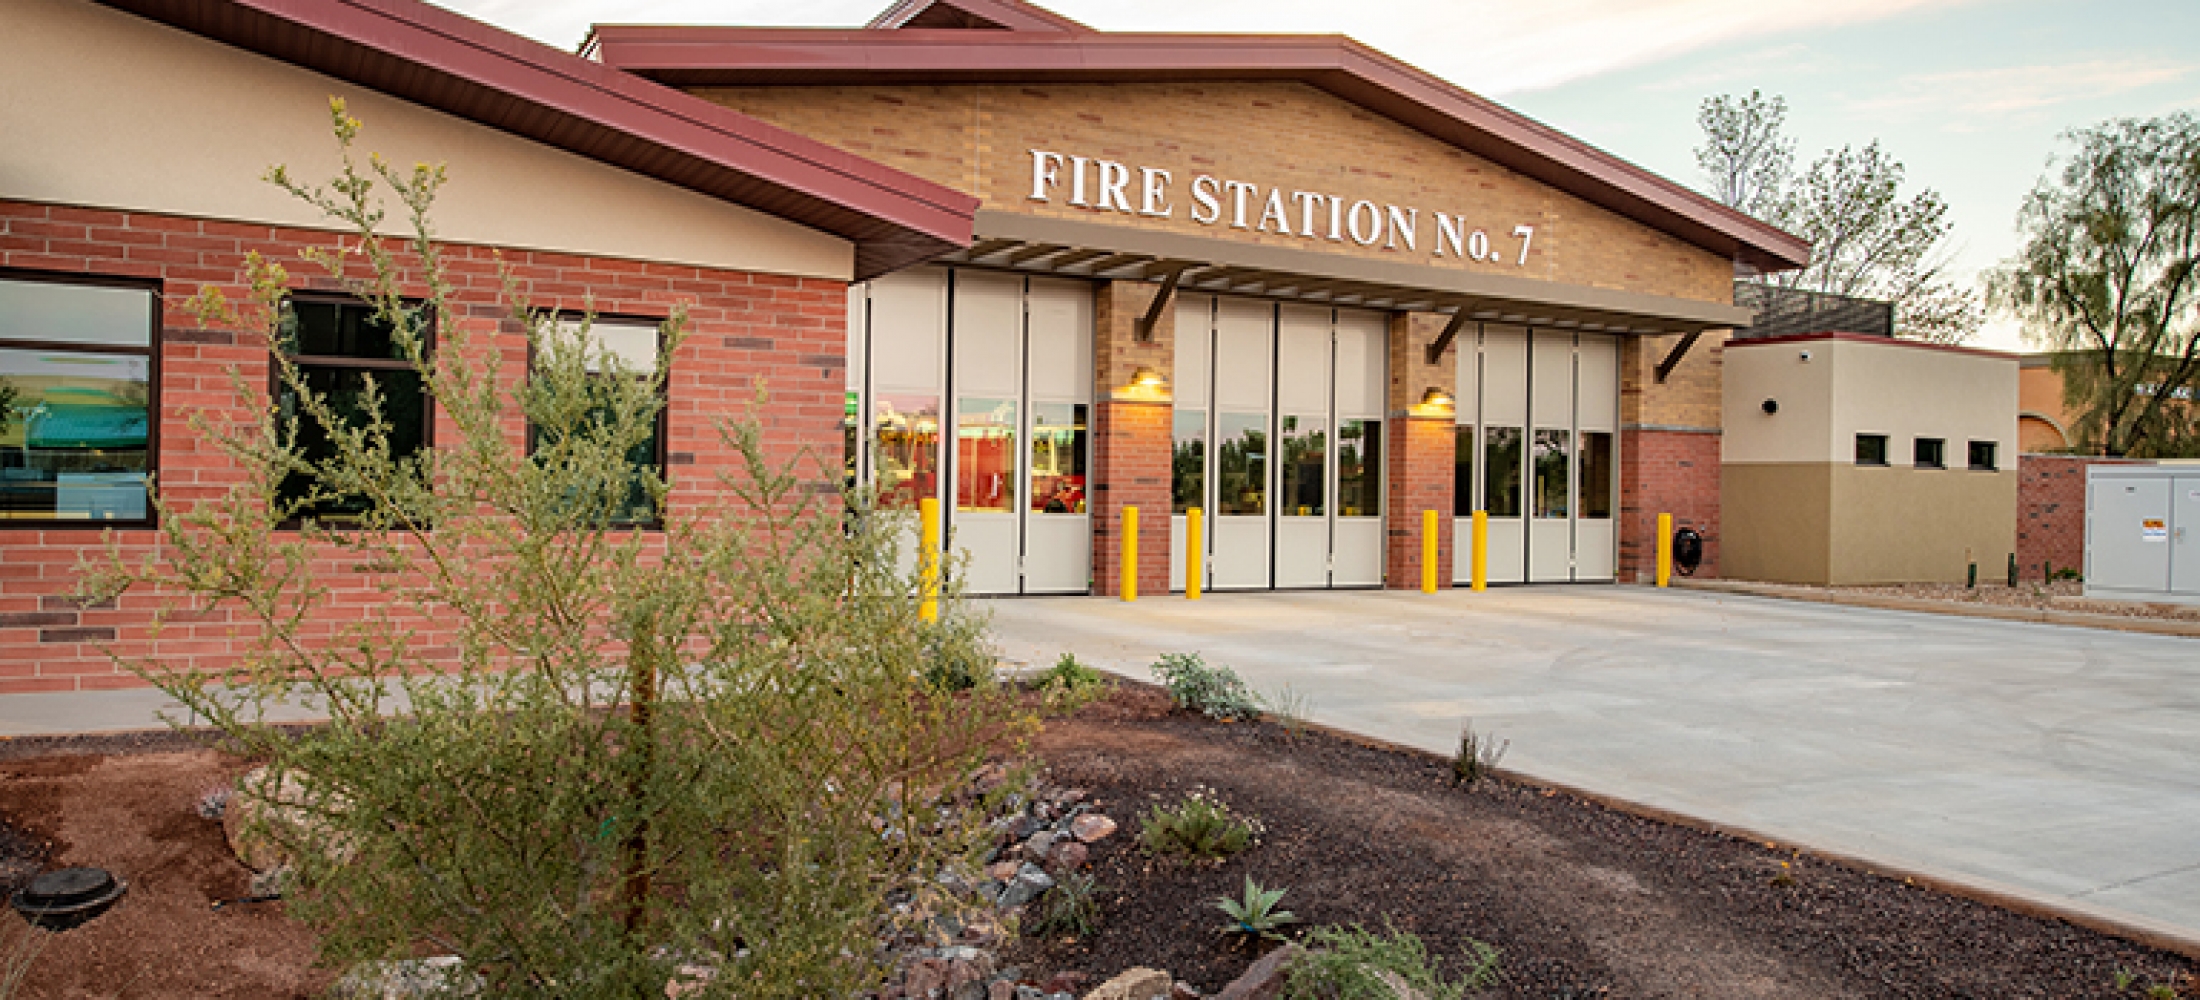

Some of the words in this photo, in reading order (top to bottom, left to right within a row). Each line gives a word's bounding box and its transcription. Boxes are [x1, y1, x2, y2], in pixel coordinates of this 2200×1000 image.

[1027, 148, 1173, 217] FIRE
[1190, 174, 1418, 251] STATION
[1432, 211, 1501, 262] No.
[1513, 223, 1534, 266] 7
